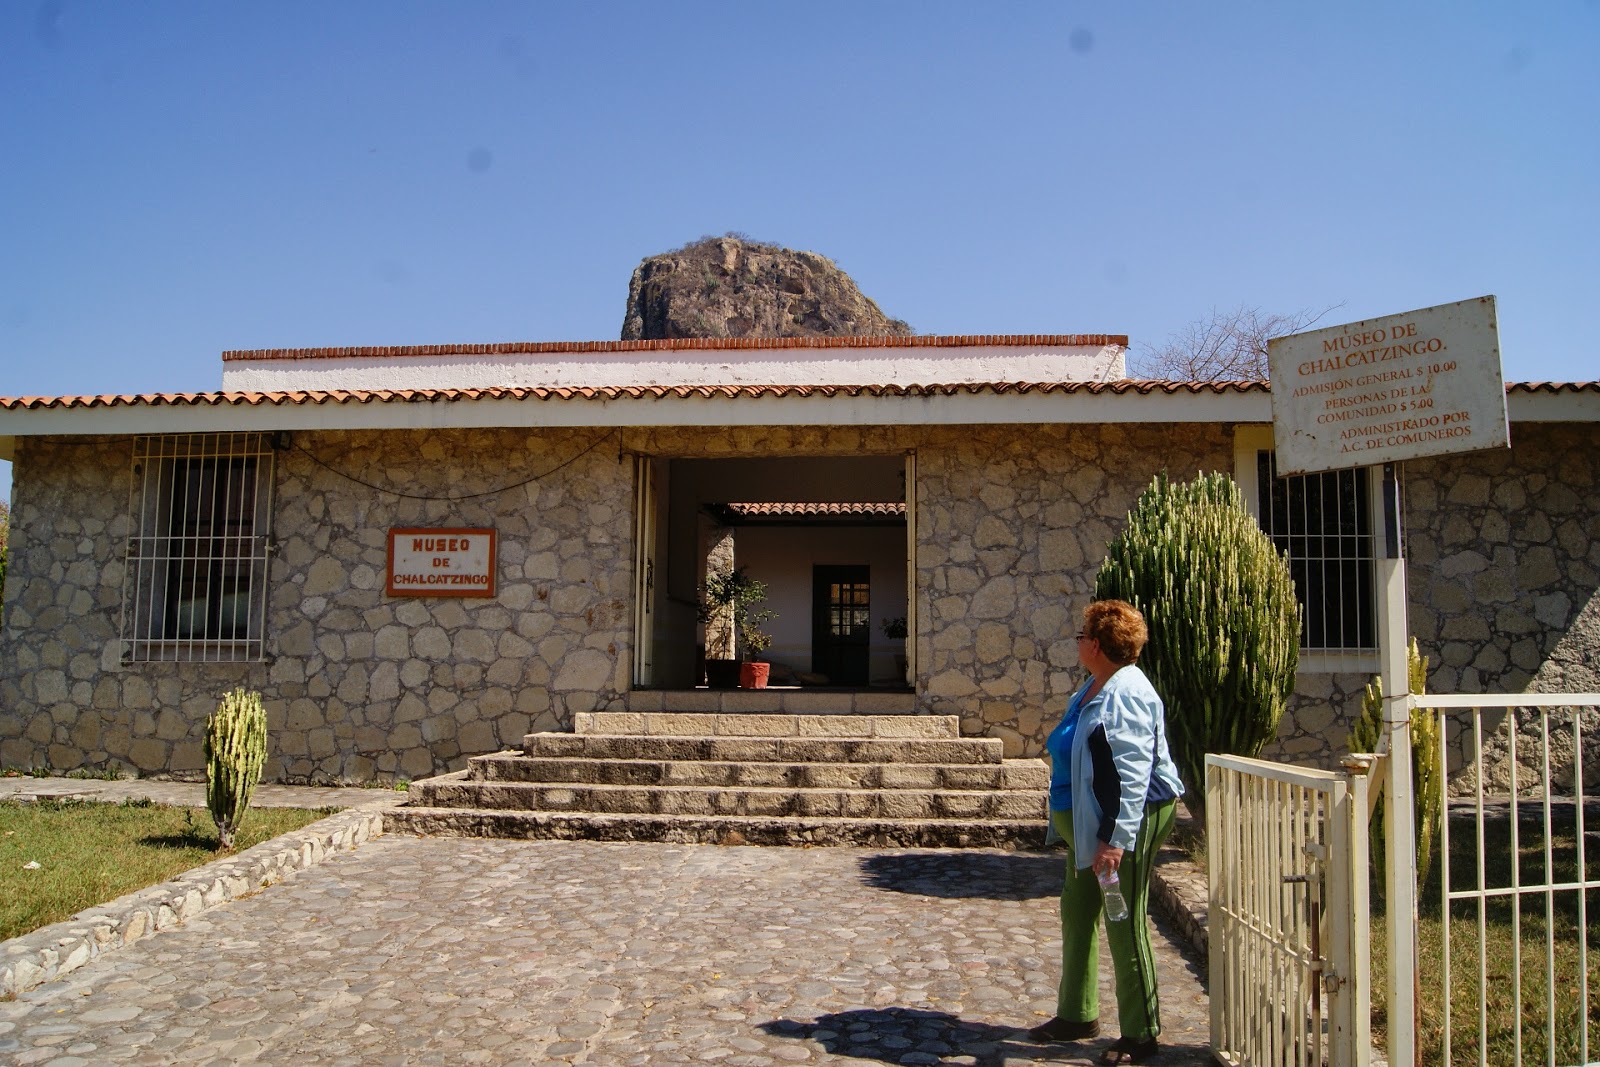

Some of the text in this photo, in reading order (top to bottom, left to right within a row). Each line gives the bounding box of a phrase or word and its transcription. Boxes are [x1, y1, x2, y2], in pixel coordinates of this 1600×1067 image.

[1323, 323, 1418, 353] MUSEO DE
[1292, 360, 1457, 398] ADMISIÓN GENERAL $ 10.00
[1325, 385, 1428, 410] PERSONAS DE LA
[1317, 398, 1433, 425] COMUNIDAD $ 5.00
[1340, 411, 1470, 440] ADMINISTRADO POR
[1341, 426, 1472, 453] A.C. DE COMUNEROS
[413, 538, 470, 552] MUSEO
[432, 557, 450, 568] DE
[394, 574, 488, 585] CHALCATZINGO
